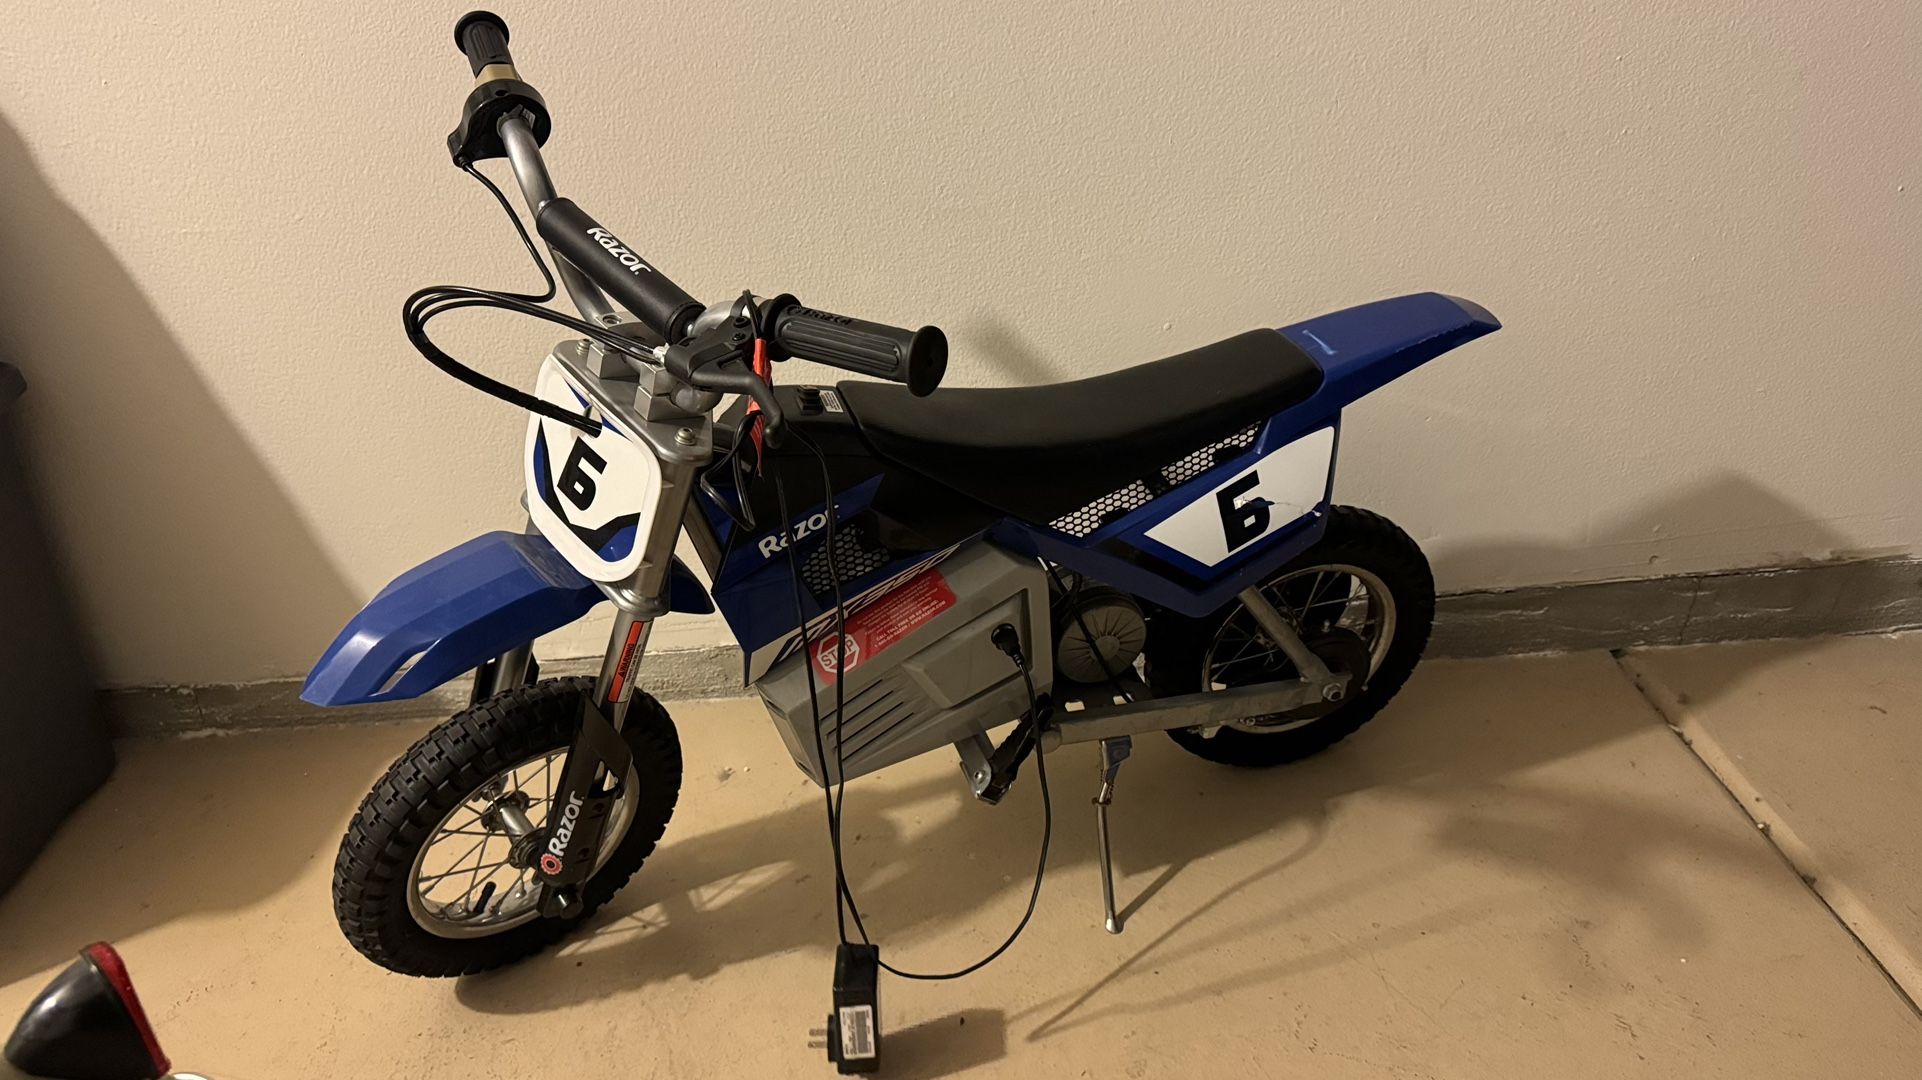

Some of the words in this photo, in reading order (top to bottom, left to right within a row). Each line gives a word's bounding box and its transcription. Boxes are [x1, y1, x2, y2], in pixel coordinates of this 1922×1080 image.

[587, 227, 651, 275] Razor
[557, 436, 607, 511] 6
[1216, 469, 1272, 553] 6
[619, 643, 635, 671] WARNING
[822, 639, 853, 666] STP
[549, 790, 584, 857] Razor
